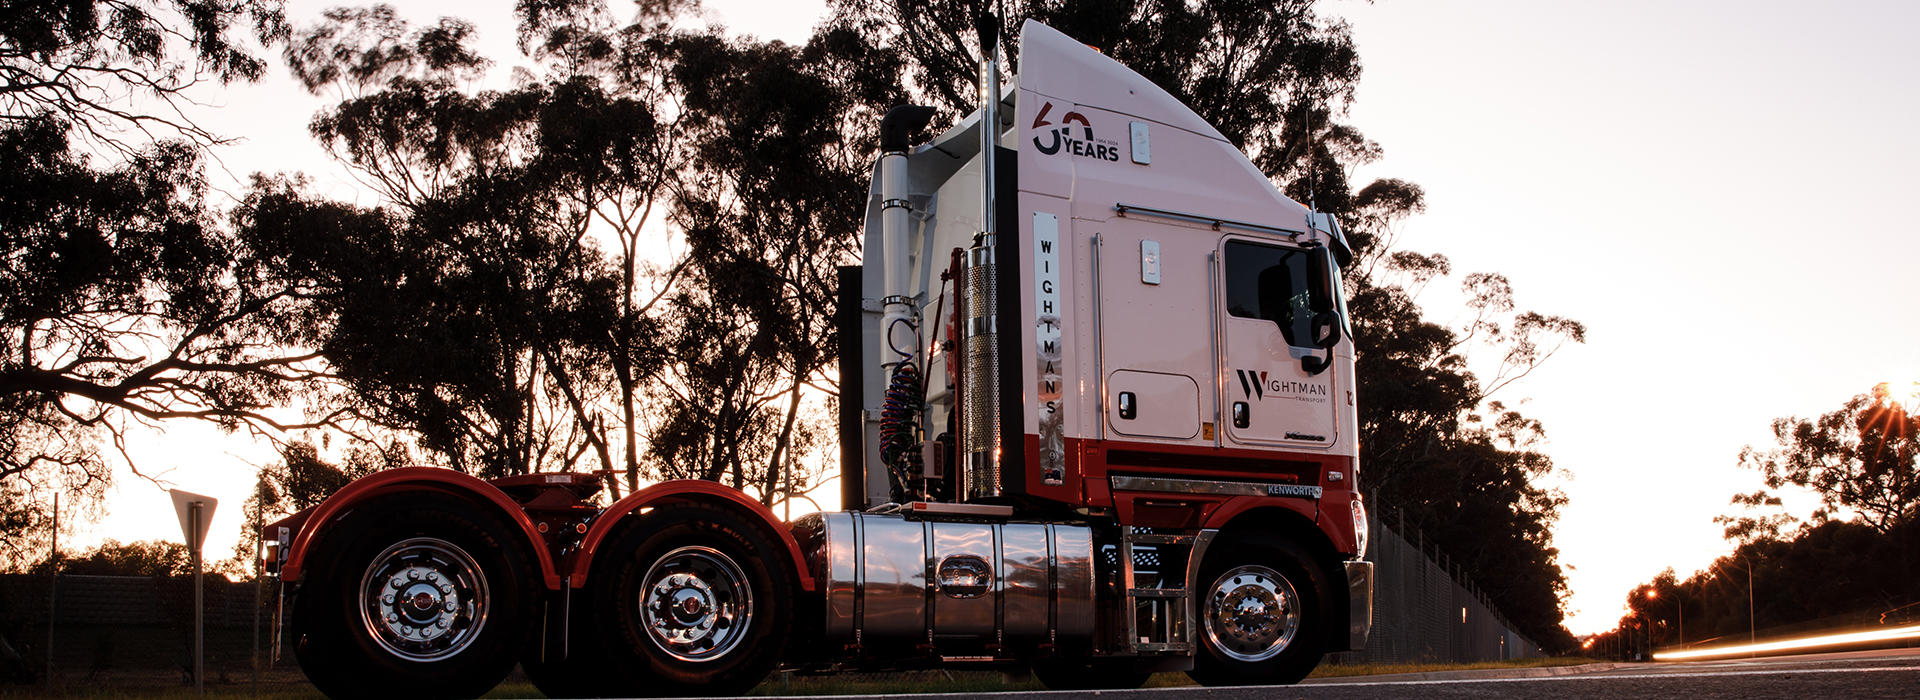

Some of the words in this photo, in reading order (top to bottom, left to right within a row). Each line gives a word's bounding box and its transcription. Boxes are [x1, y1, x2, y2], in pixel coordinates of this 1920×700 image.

[1032, 101, 1094, 155] 60
[1062, 136, 1119, 162] YEARS
[1041, 240, 1056, 414] WIGHTMANS
[1295, 396, 1326, 404] TRANSPORT
[1268, 485, 1314, 496] KENWORTH
[409, 508, 499, 549] MICHELIN
[722, 526, 755, 551] MULTI
